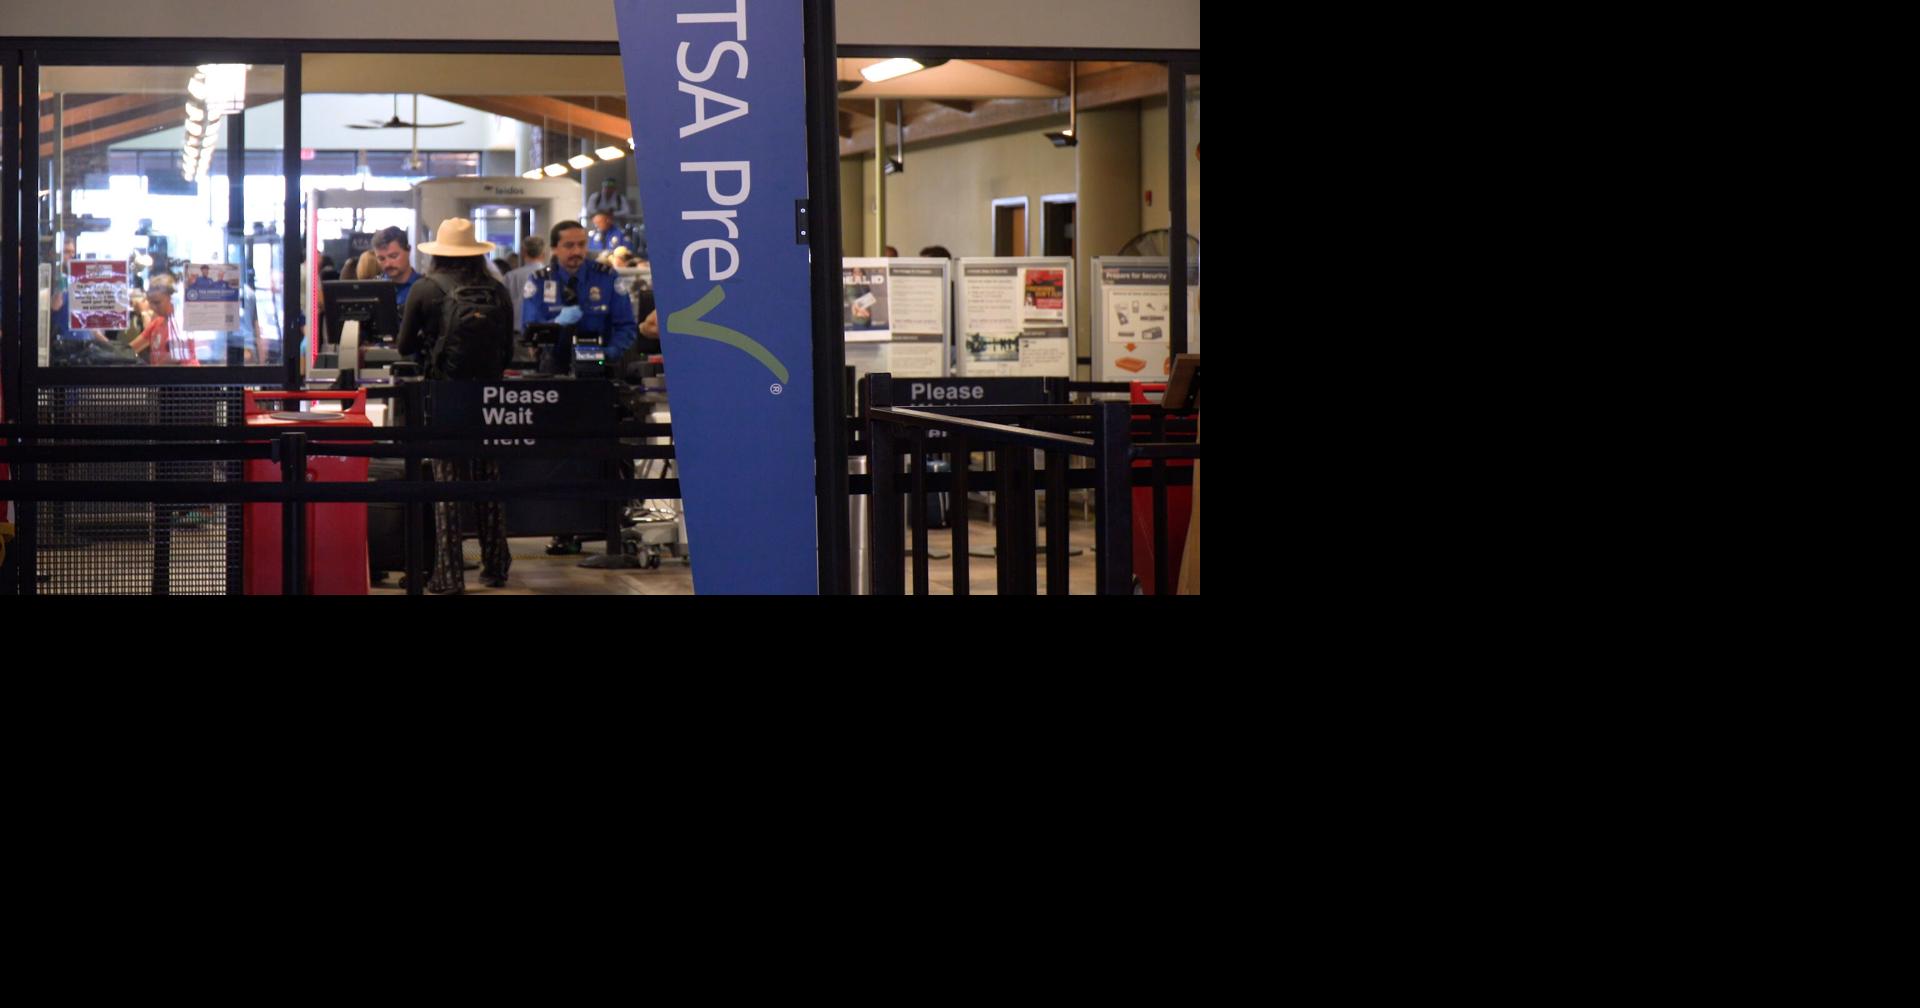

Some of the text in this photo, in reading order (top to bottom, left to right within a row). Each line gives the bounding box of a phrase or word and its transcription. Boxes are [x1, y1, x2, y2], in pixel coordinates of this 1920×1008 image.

[676, 0, 749, 138] TSA
[483, 386, 560, 404] Please
[911, 383, 985, 401] Please
[482, 407, 535, 425] Wait
